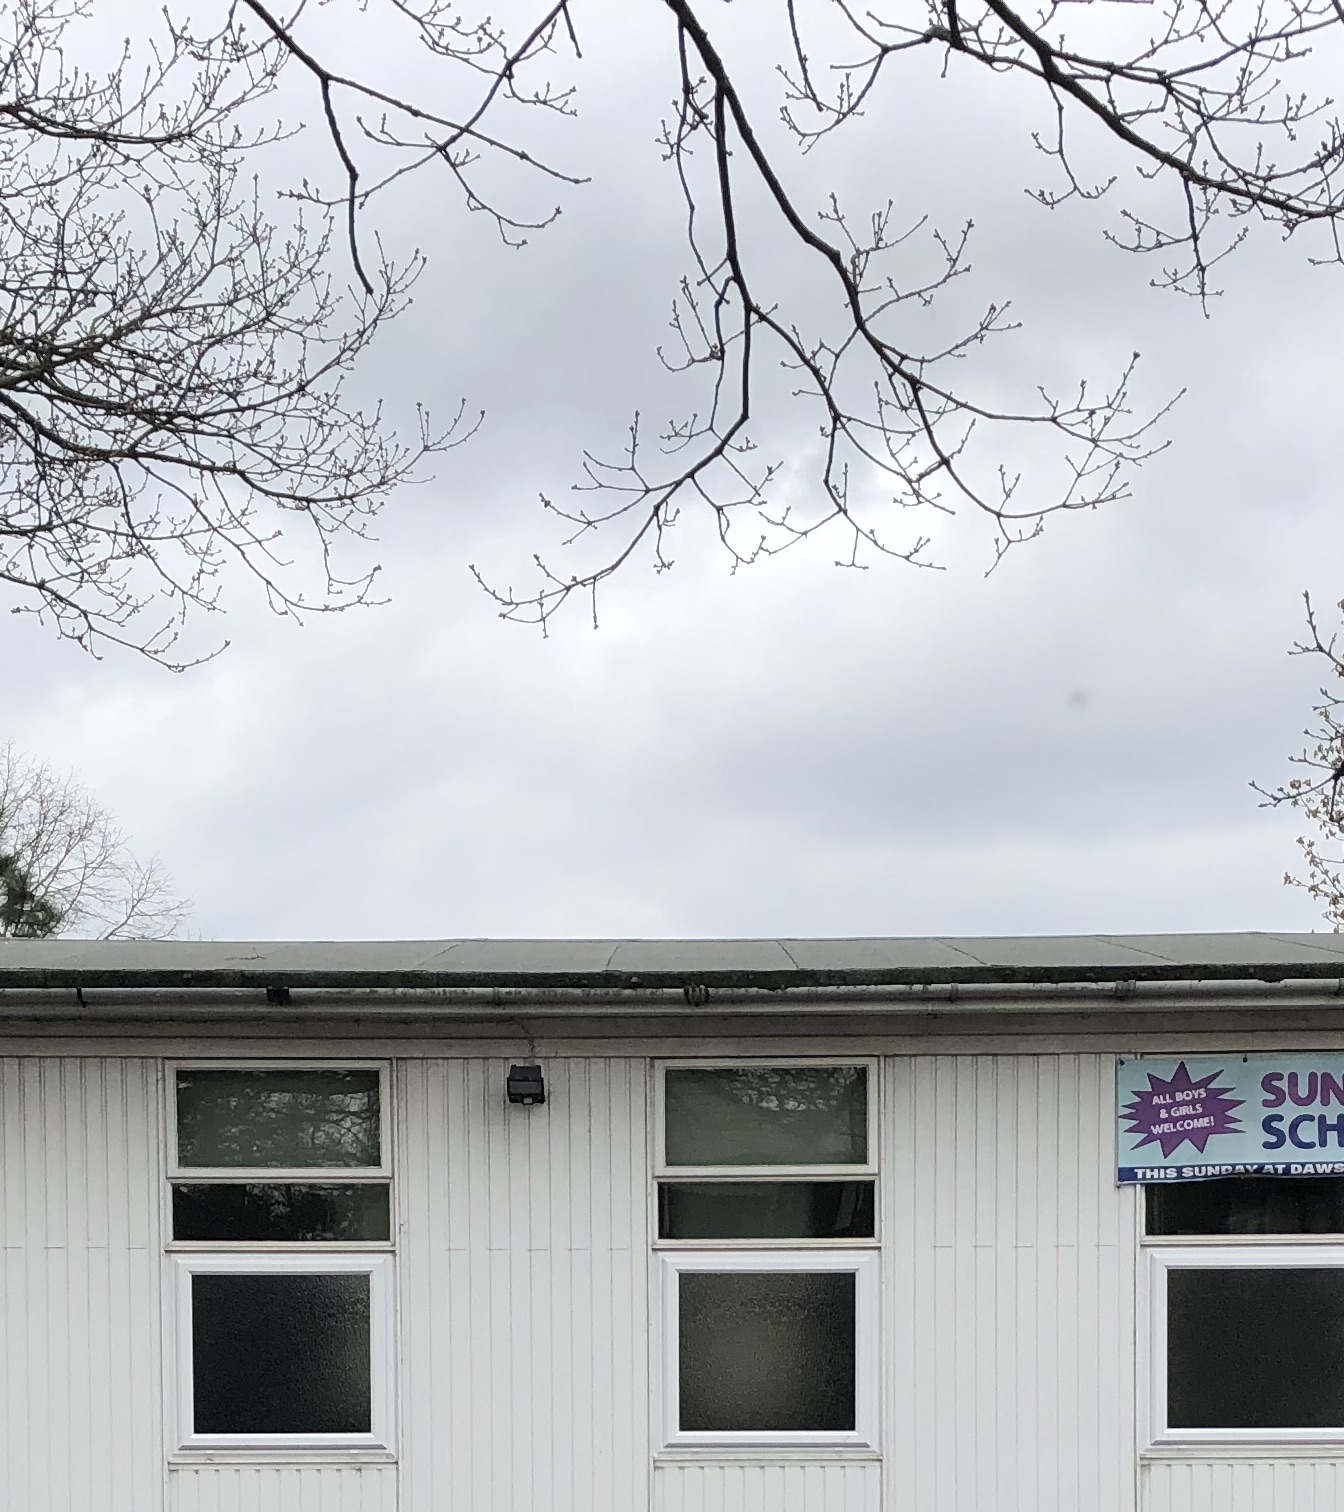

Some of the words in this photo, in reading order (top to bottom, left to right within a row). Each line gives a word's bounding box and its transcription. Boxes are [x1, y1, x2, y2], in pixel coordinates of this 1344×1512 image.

[1152, 1093, 1173, 1105] ALL
[1174, 1087, 1207, 1102] BOYS
[1159, 1108, 1168, 1119] &
[1170, 1103, 1203, 1117] GIRLS
[1150, 1115, 1215, 1135] WELCOME!
[1134, 1167, 1178, 1179] THIS
[1181, 1164, 1258, 1177] SUNDAY
[1262, 1164, 1286, 1175] AT
[1290, 1163, 1344, 1175] DAWS
